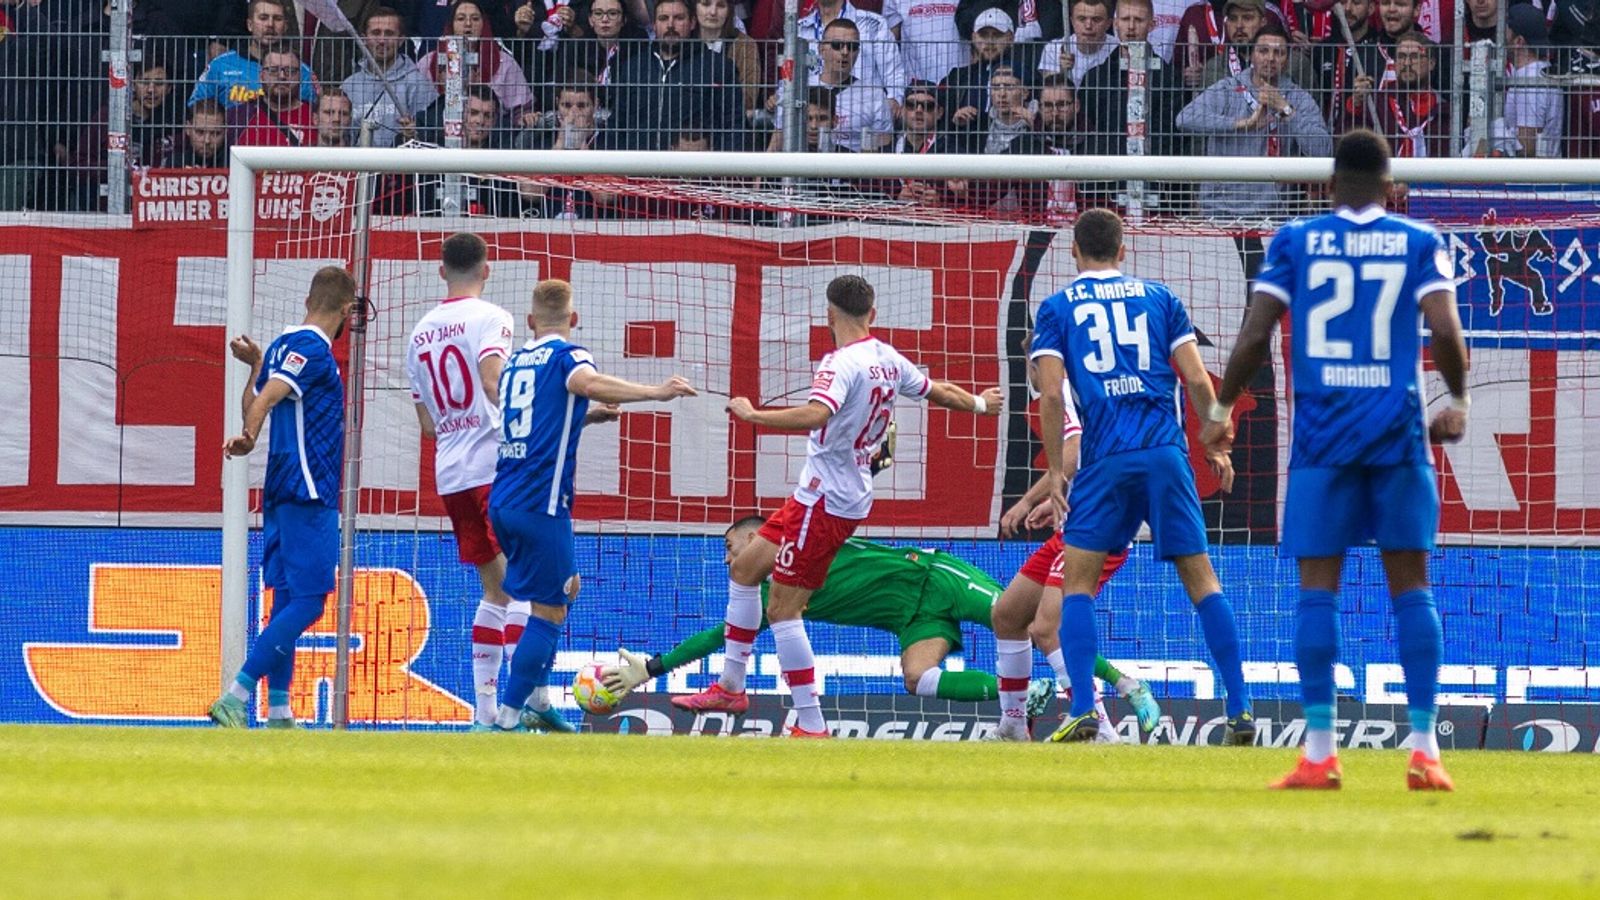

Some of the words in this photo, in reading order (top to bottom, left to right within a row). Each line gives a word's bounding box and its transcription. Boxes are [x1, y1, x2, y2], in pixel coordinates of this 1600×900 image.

[139, 175, 231, 197] CHRISTO
[261, 171, 304, 196] FÜR
[138, 200, 212, 222] IMMER
[257, 198, 302, 221] UNS
[1306, 231, 1341, 256] F.C.
[1343, 231, 1408, 257] HANSA
[1065, 285, 1094, 303] F.C.
[1095, 282, 1146, 300] HANSA
[1307, 260, 1408, 360] 27
[414, 329, 435, 347] SSV
[438, 322, 466, 342] JAHN
[1074, 301, 1150, 374] 34
[418, 344, 474, 417] 10
[1103, 375, 1146, 397] FRÖDE
[499, 367, 536, 443] 19
